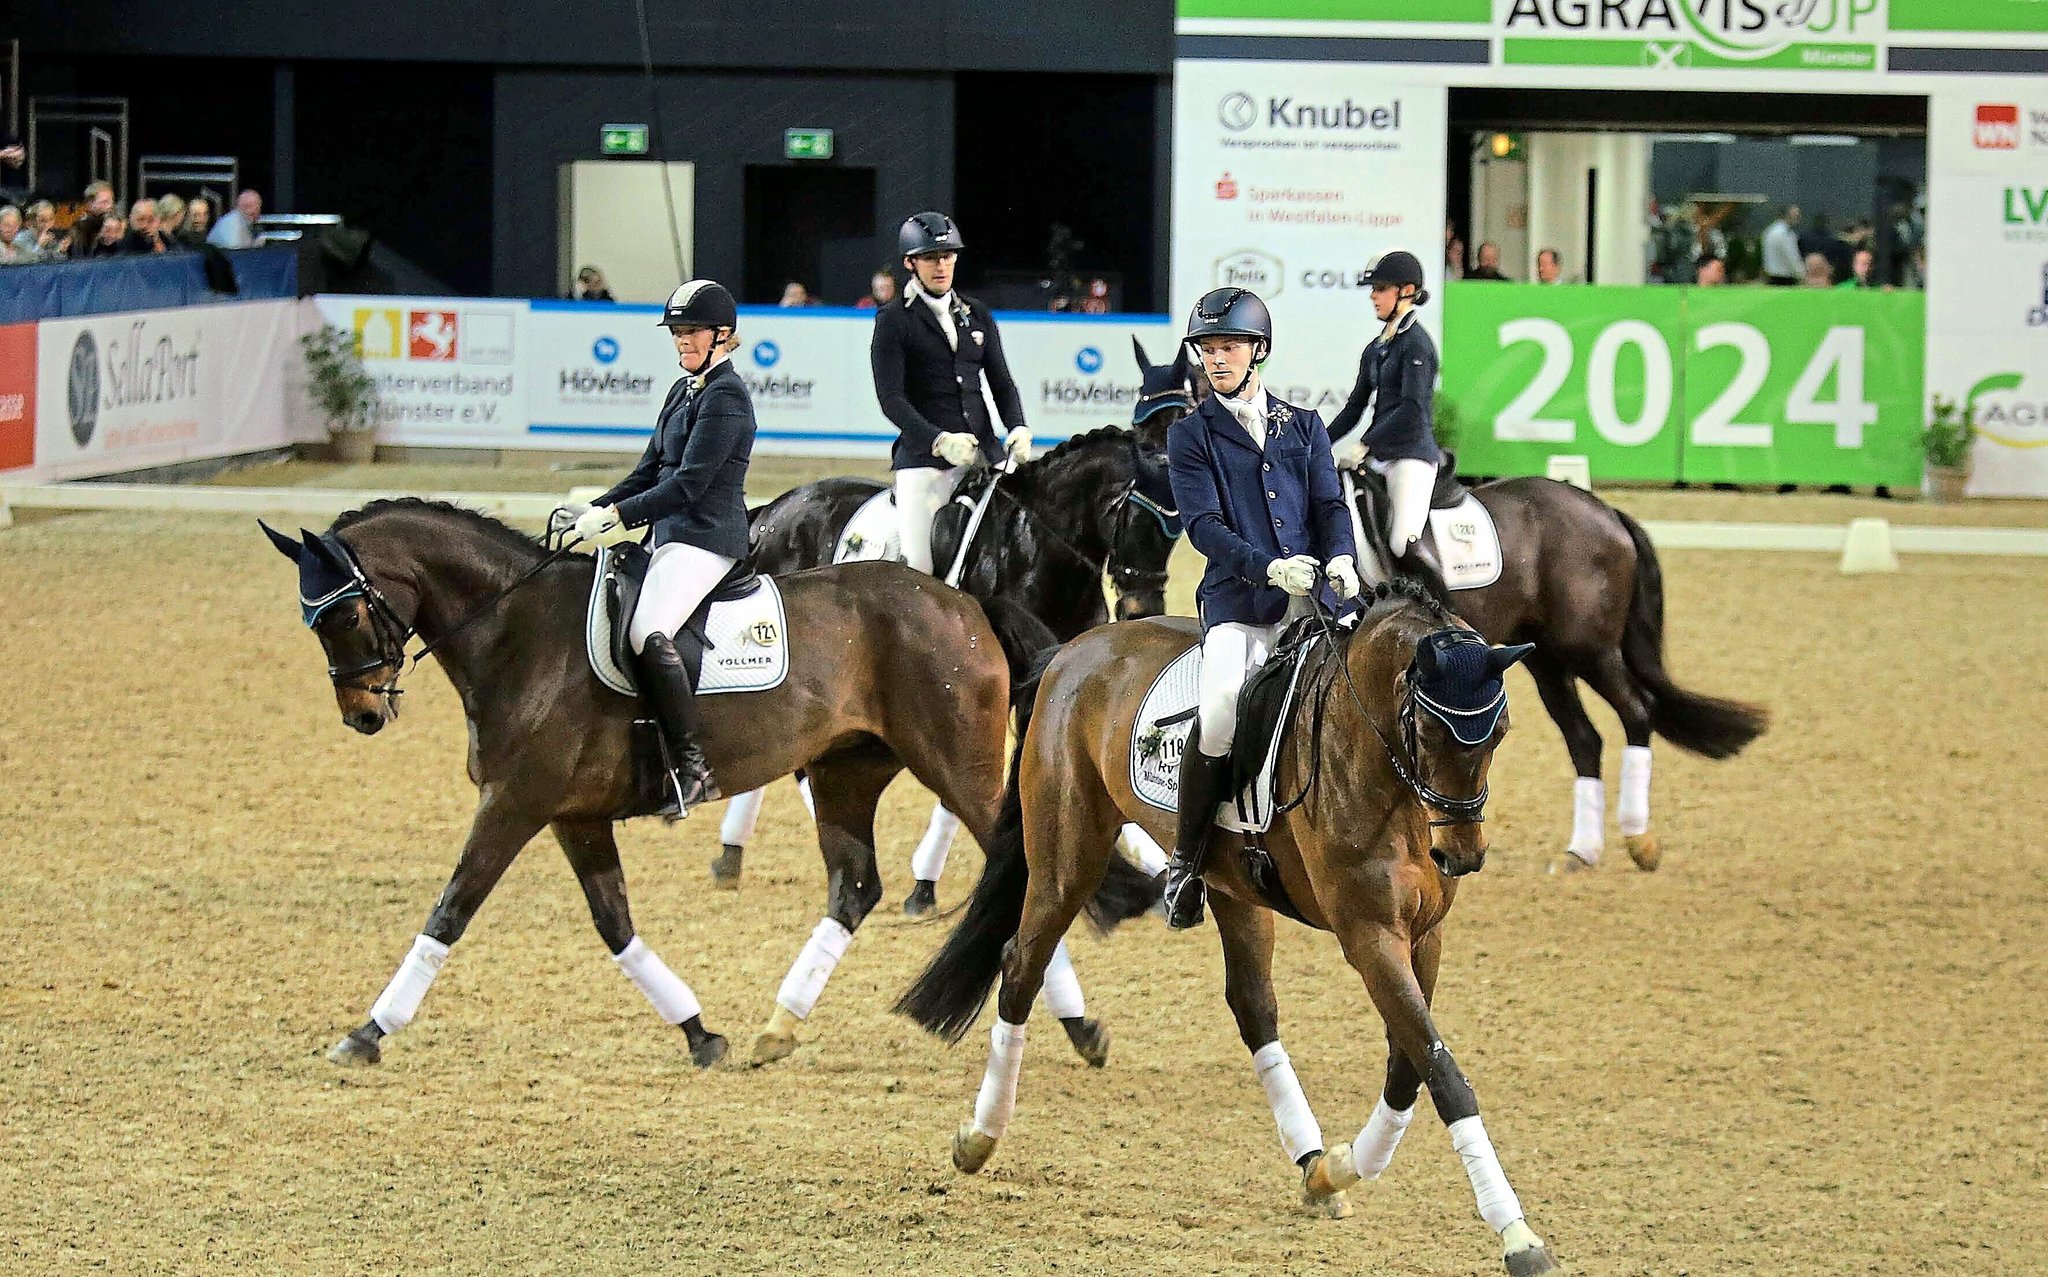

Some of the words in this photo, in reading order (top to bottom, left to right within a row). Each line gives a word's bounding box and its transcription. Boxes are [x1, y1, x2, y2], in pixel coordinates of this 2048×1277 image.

[1269, 98, 1401, 130] Knubel
[2004, 186, 2048, 223] LV
[1494, 317, 1878, 449] 2024
[717, 656, 772, 666] VOLLMER
[1161, 737, 1184, 760] 118
